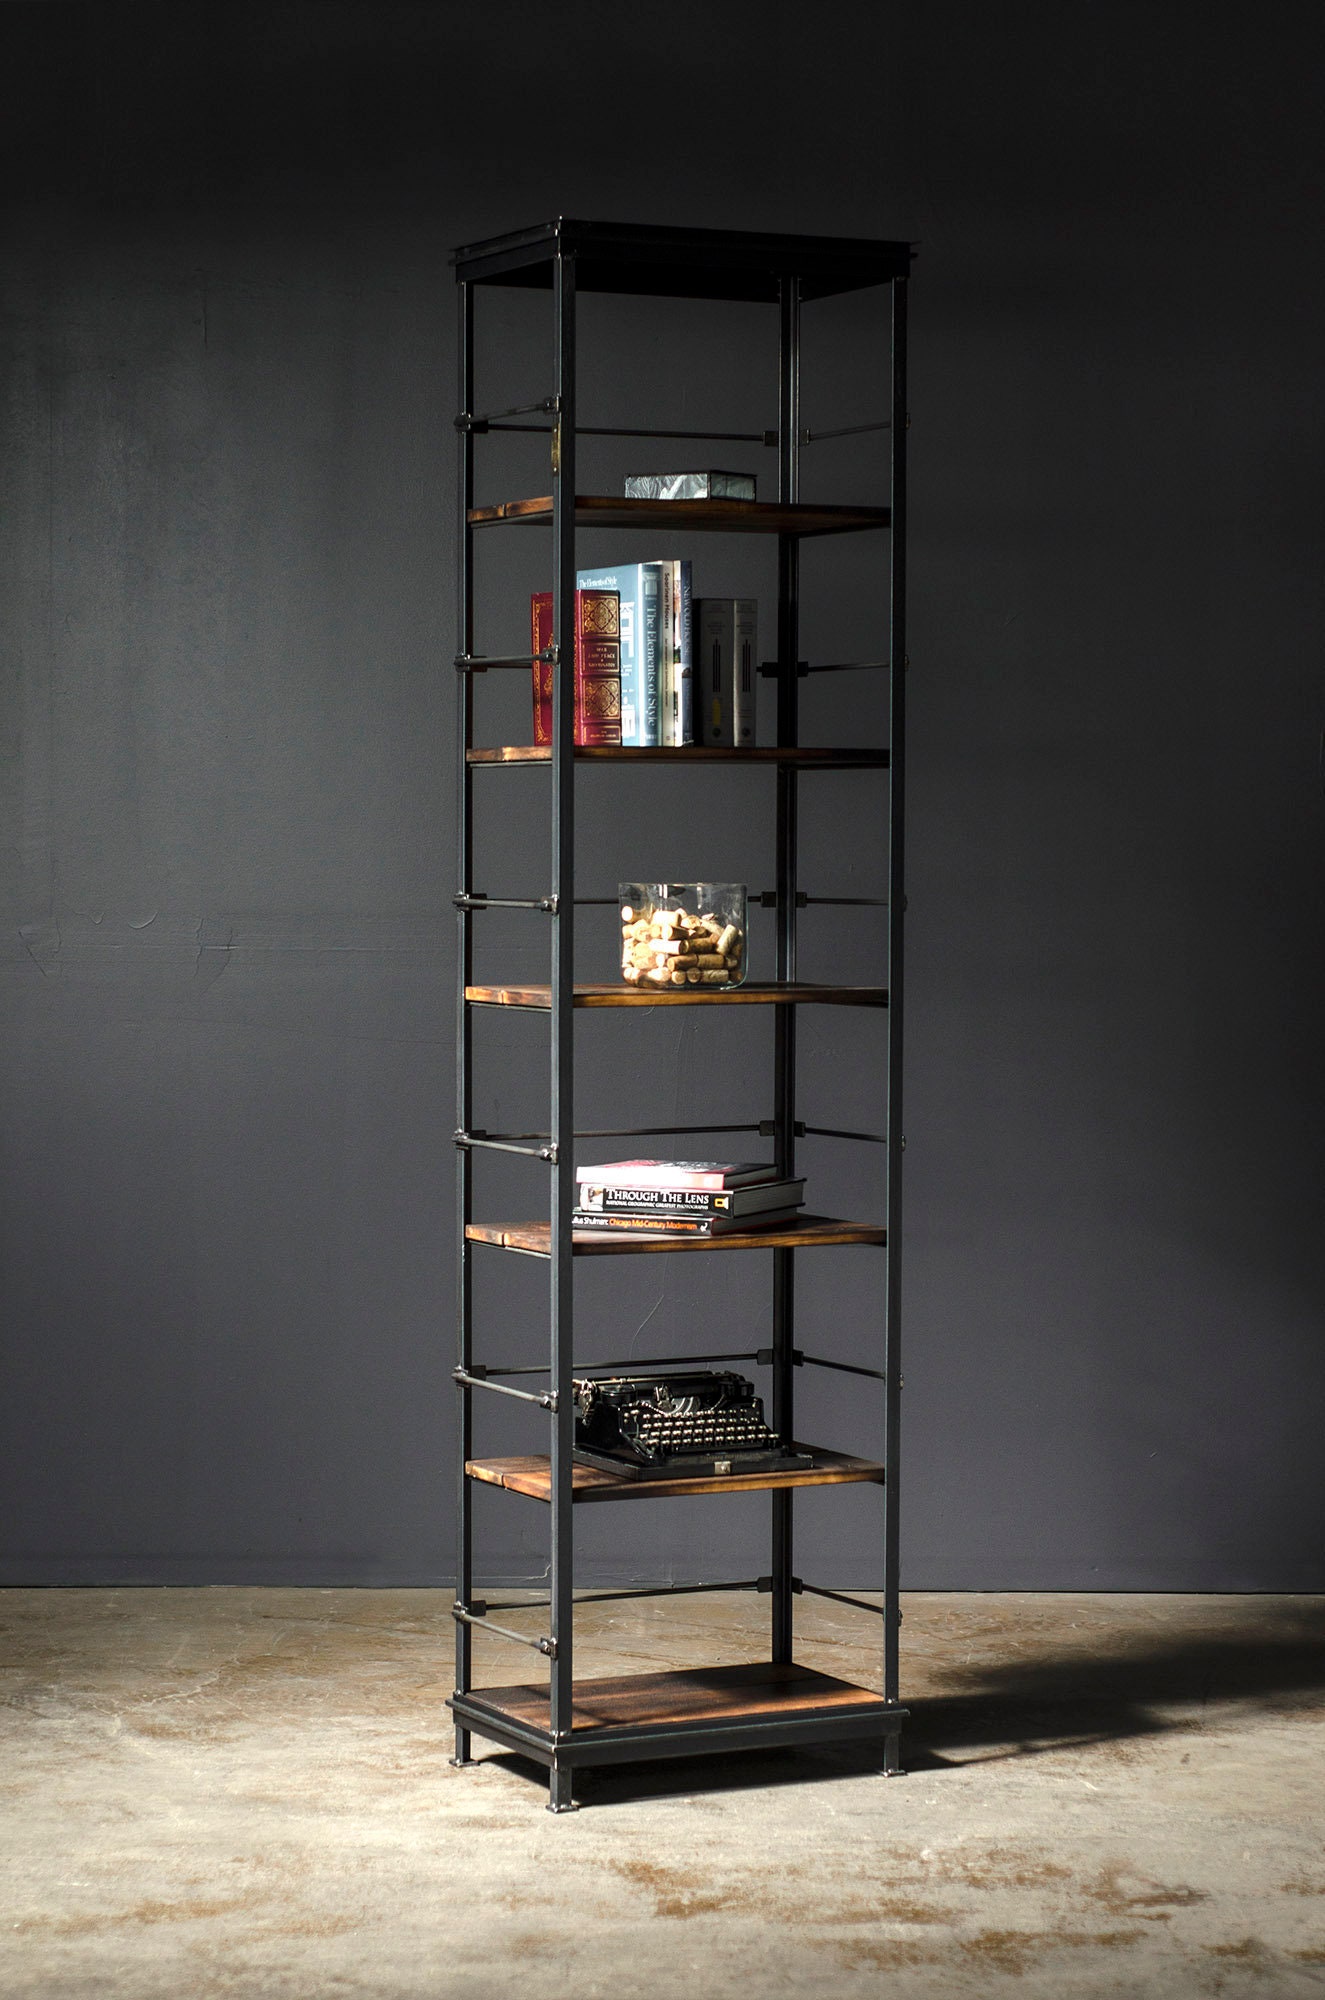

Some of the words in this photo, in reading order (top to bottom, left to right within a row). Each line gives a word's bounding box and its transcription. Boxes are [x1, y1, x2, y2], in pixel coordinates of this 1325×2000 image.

[587, 578, 604, 587] Elements
[607, 575, 618, 586] Style
[646, 605, 657, 628] The
[646, 631, 657, 681] Elements
[647, 683, 657, 694] of
[645, 698, 657, 726] Style
[606, 1188, 658, 1201] THROUGH
[660, 1190, 682, 1203] THE
[685, 1192, 709, 1204] LENS
[609, 1218, 631, 1228] Chicago
[632, 1219, 665, 1230] Mid-Century
[666, 1221, 697, 1230] Modernism
